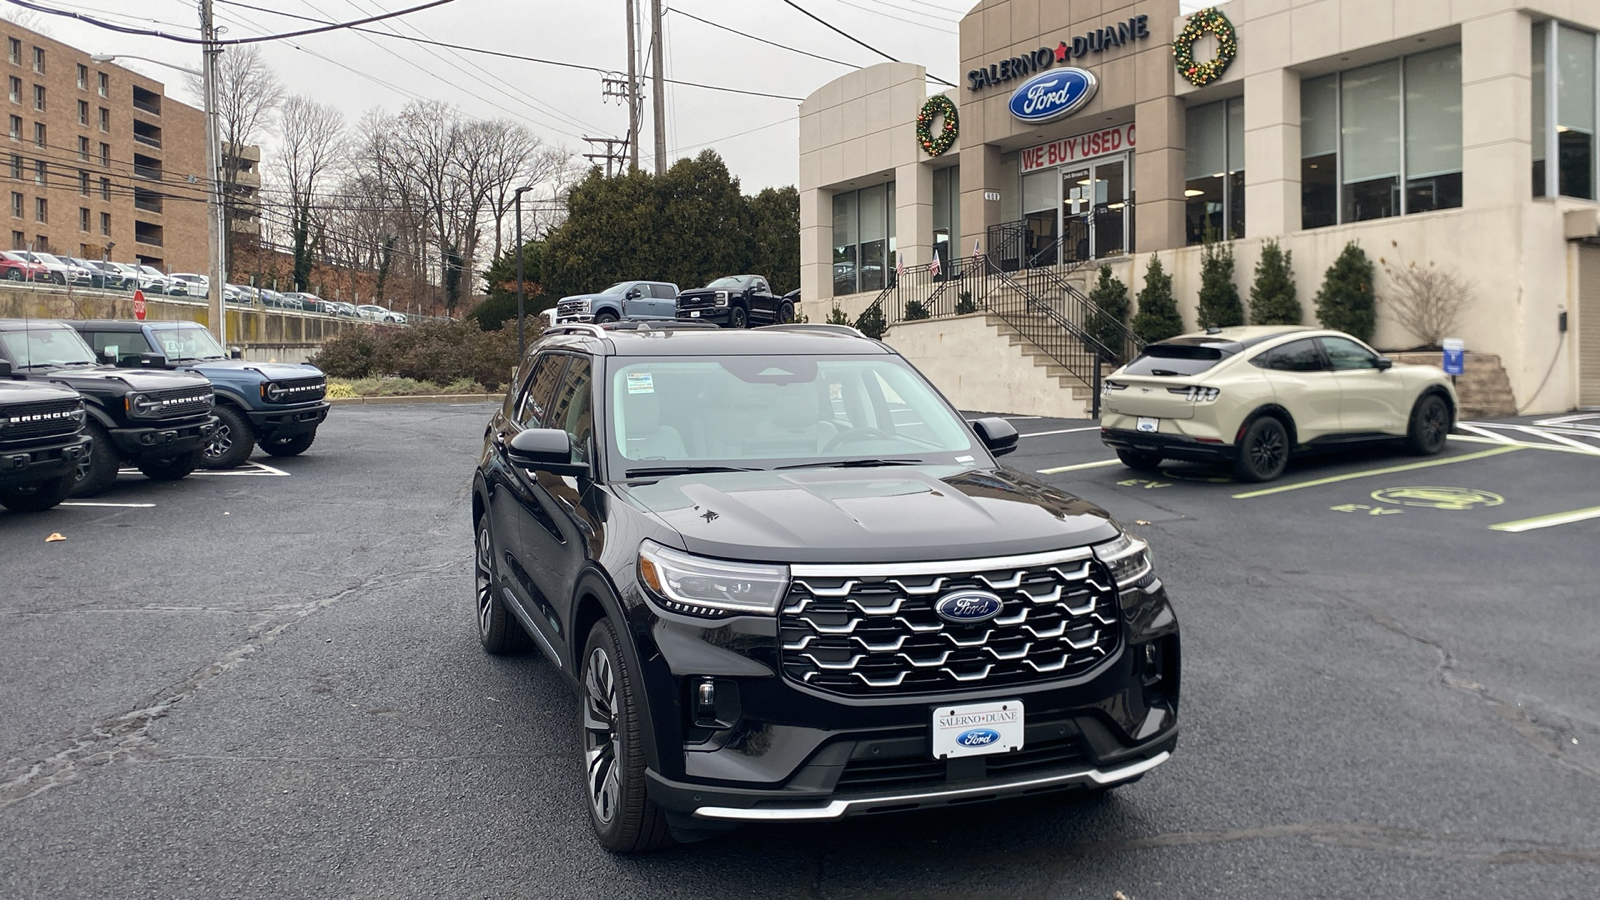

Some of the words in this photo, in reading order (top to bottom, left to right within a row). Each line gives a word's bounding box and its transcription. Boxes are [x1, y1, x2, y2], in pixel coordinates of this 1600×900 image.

[967, 46, 1055, 91] SALERNO
[1071, 14, 1150, 59] DUANE
[1023, 79, 1071, 114] Ford
[1022, 147, 1044, 170] WE
[1048, 137, 1078, 164] BUY
[1081, 130, 1121, 157] USED
[134, 300, 145, 314] STOP
[289, 384, 321, 393] BRONCO
[162, 395, 205, 405] BRONCO
[10, 411, 70, 423] BRONCO
[953, 598, 990, 615] Ford
[939, 714, 981, 727] SALERNO
[985, 711, 1018, 723] DUANE
[964, 731, 992, 745] Ford
